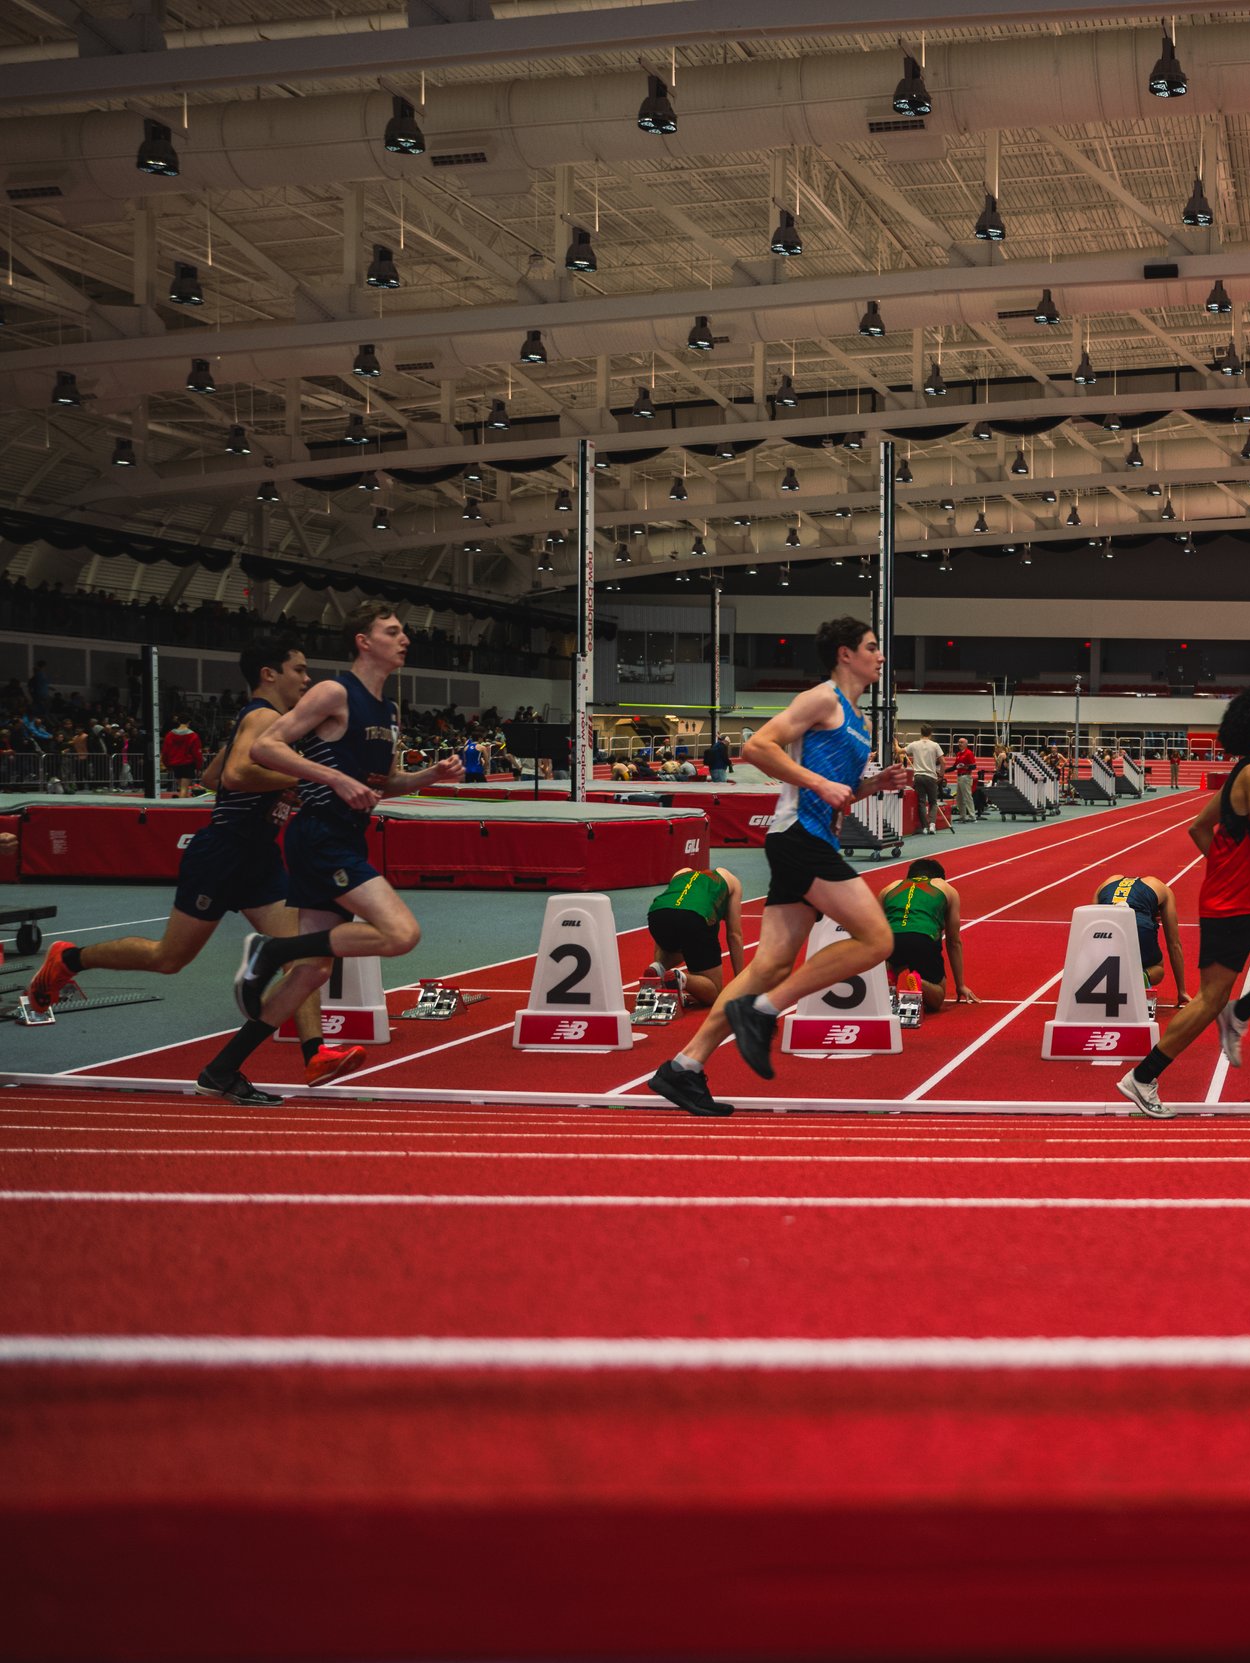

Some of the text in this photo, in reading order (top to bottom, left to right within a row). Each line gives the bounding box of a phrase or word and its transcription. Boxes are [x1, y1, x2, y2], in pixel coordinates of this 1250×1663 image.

[748, 815, 775, 826] GIL
[546, 943, 592, 1005] 2
[1075, 956, 1127, 1017] 4
[551, 1020, 588, 1040] NB
[822, 1025, 860, 1044] NB
[1083, 1031, 1121, 1051] NB
